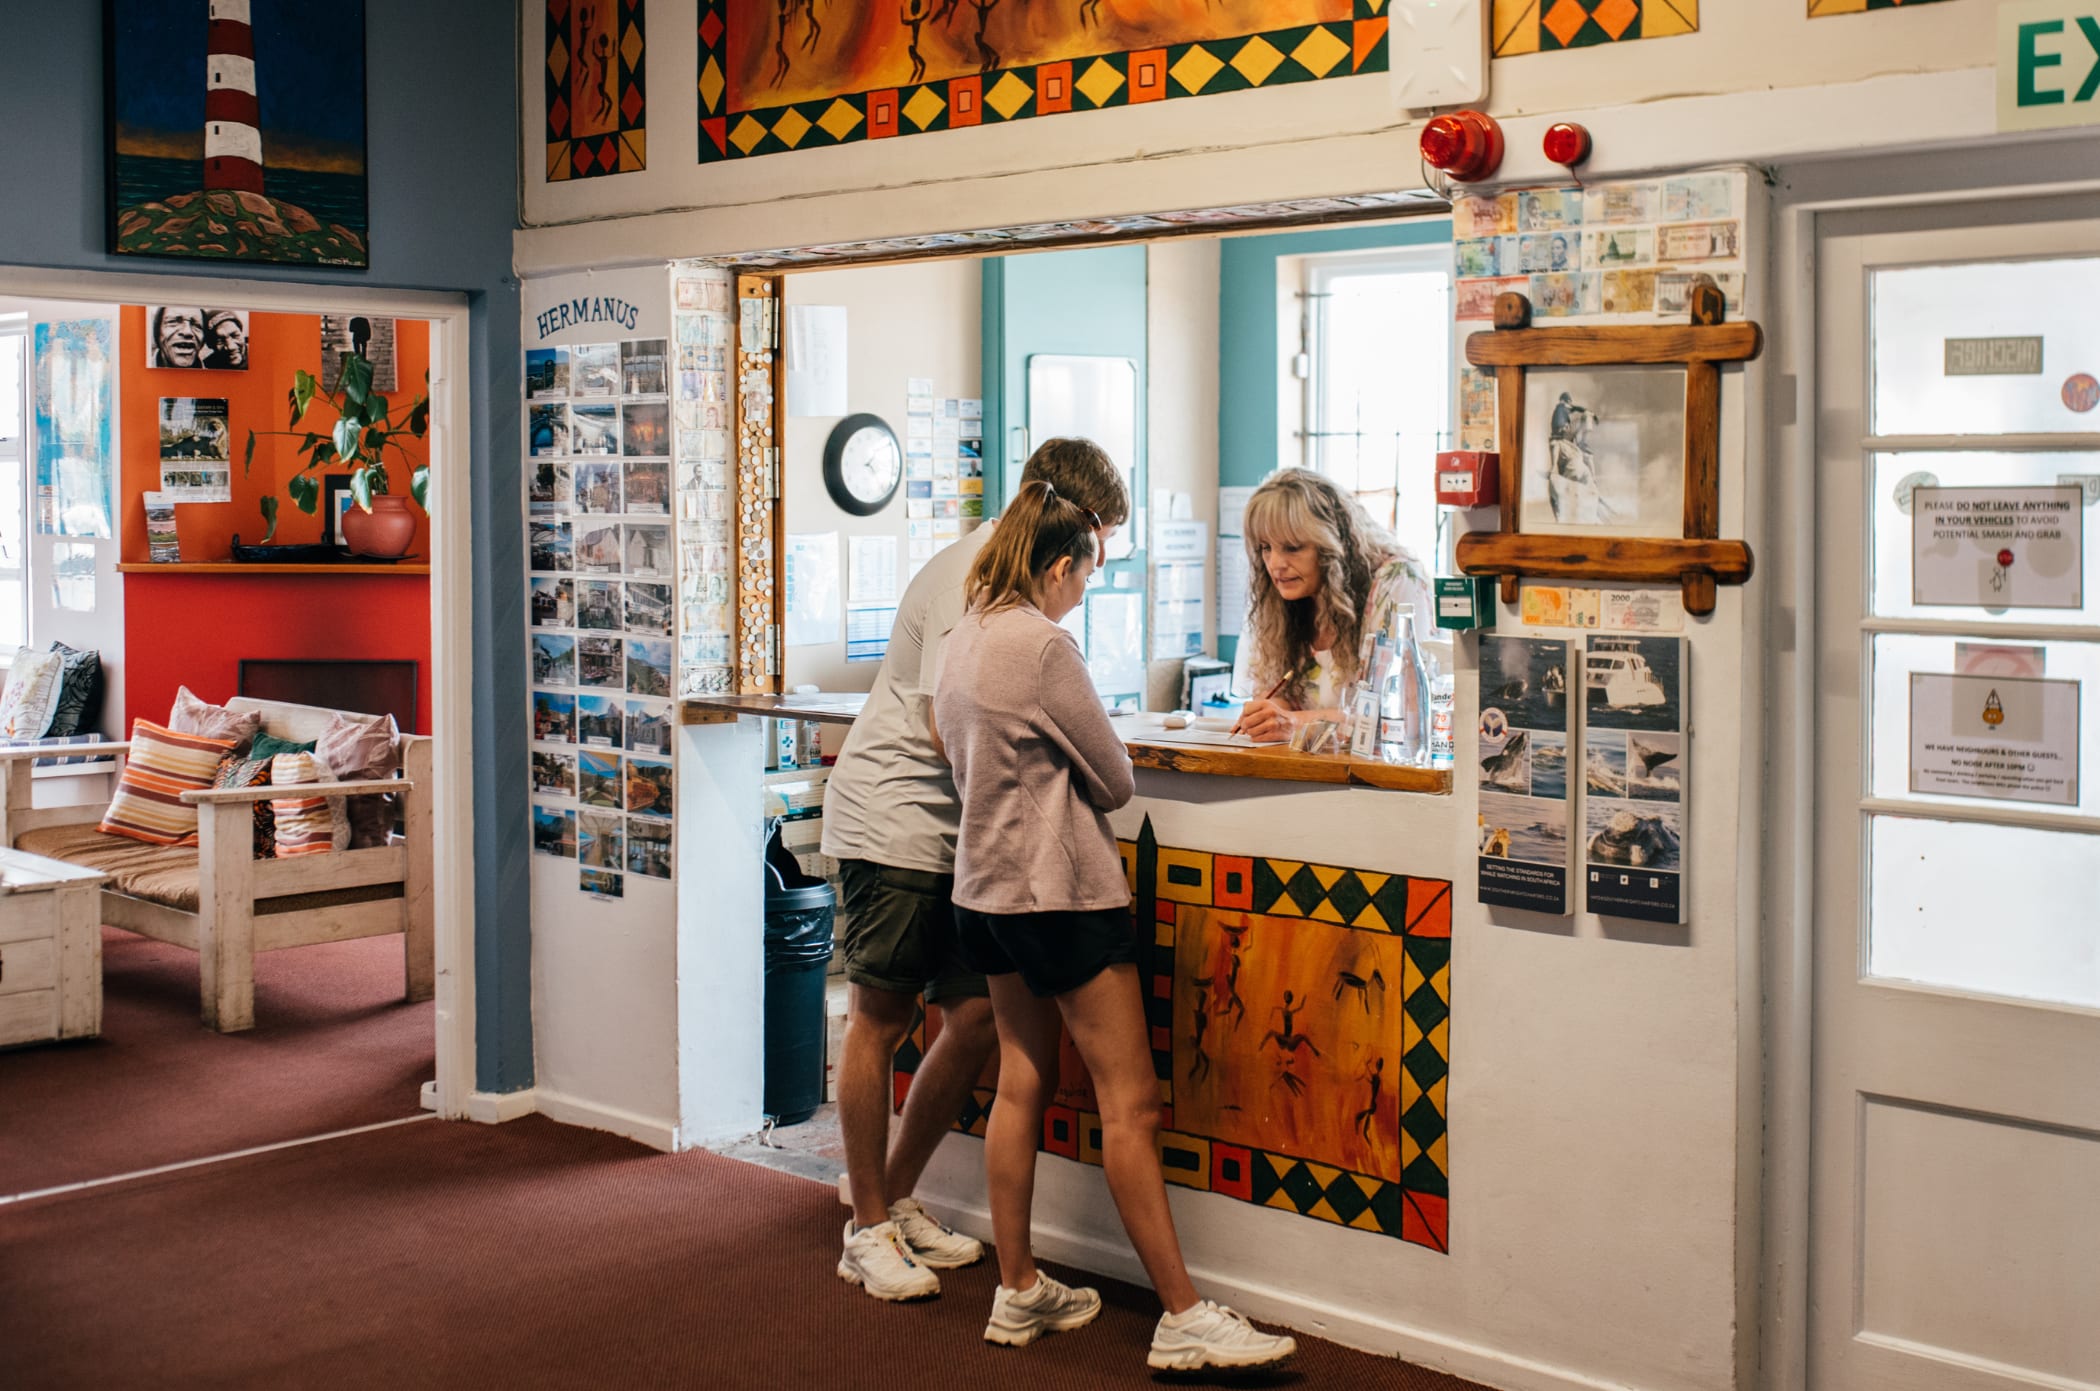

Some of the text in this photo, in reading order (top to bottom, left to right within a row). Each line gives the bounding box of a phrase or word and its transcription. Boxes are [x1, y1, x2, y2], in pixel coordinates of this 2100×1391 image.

[537, 297, 639, 340] HERMANUS
[1925, 501, 2070, 512] PLEASE DO NOT LEAVE ANYTHING
[1935, 516, 2059, 525] IN YOUR VEHICLES TO AVOID
[1933, 530, 2061, 539] POTENTIAL SMASH AND GRAB
[1956, 746, 2000, 756] NEIGHBOURS
[2007, 750, 2030, 758] OTHER
[1963, 760, 1983, 768] NOISE
